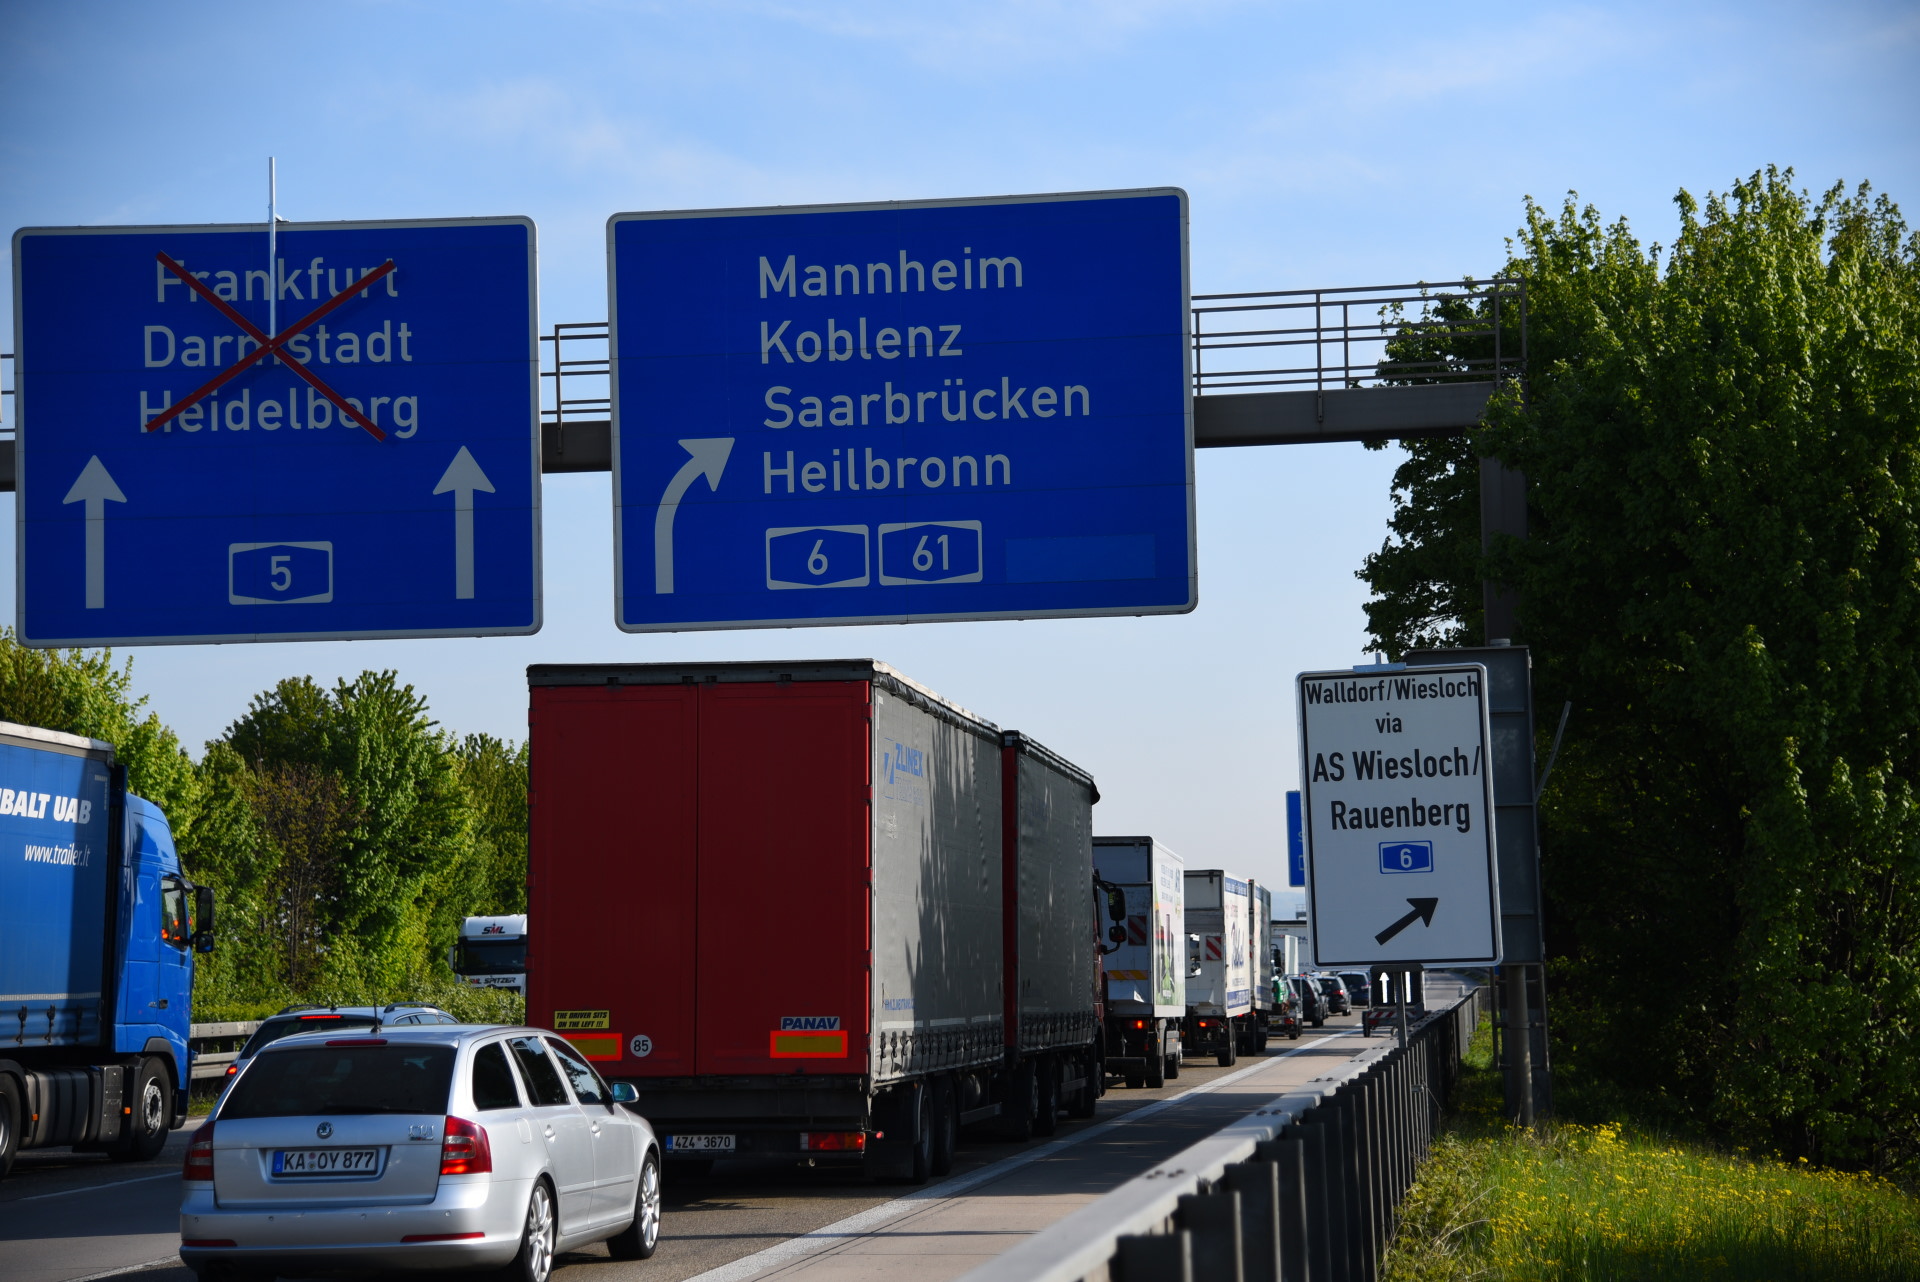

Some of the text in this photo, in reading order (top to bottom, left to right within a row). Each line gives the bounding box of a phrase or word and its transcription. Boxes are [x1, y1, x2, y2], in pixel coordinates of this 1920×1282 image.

[759, 247, 1023, 299] Mannheim
[760, 317, 963, 364] Koblenz
[764, 376, 1091, 429] Saarbrücken
[763, 447, 1012, 494] Heilbronn
[806, 539, 829, 576] 6
[911, 534, 950, 571] 61
[270, 555, 292, 591] 5
[1375, 712, 1402, 734] via
[895, 743, 924, 777] ZLINEX
[1313, 752, 1344, 782] AS
[0, 787, 92, 824] BALT UAB
[1331, 797, 1471, 833] Rauenberg
[24, 843, 91, 867] www.trailer.lt
[1400, 848, 1412, 868] 6
[482, 926, 505, 934] SML
[592, 1011, 607, 1019] SITS
[782, 1017, 838, 1029] PANAV
[633, 1040, 649, 1052] 85
[704, 1136, 731, 1148] 3670
